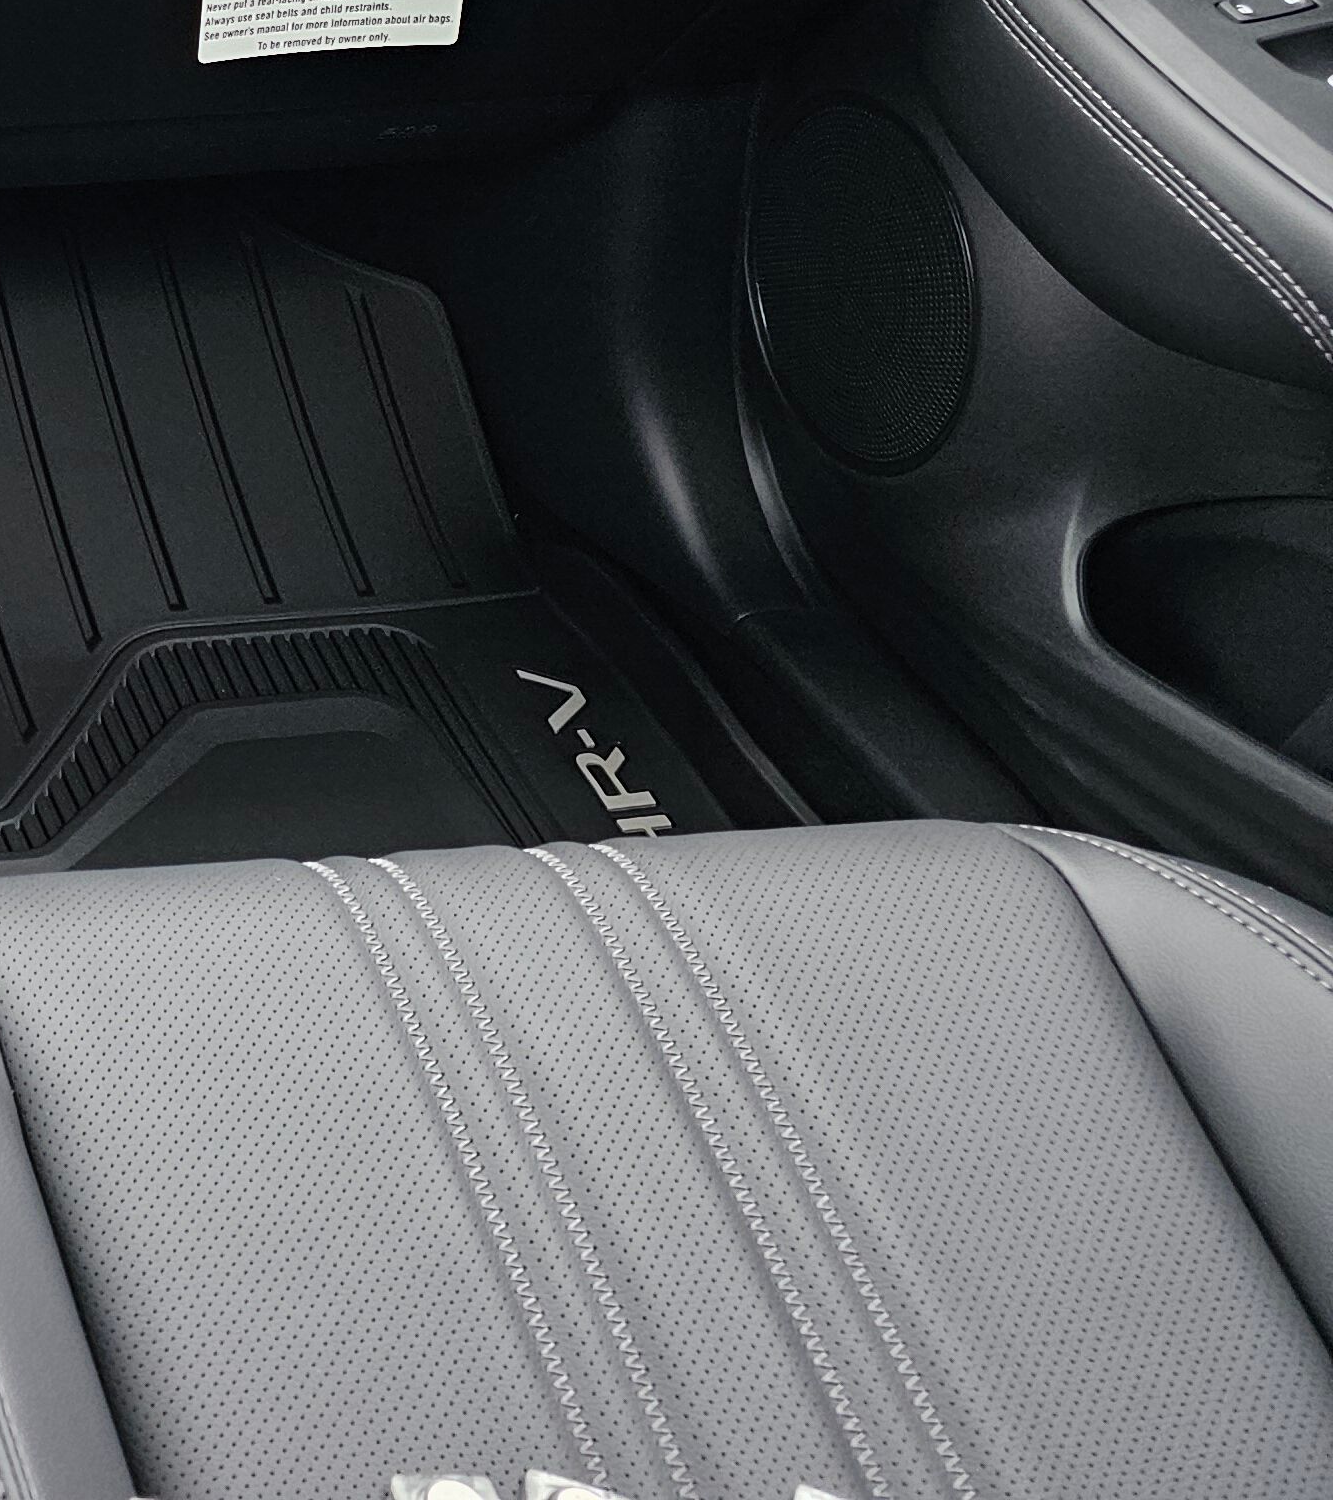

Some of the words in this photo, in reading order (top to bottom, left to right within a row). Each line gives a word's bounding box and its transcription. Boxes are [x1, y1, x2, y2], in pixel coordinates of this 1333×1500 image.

[205, 16, 234, 26] Always
[256, 11, 274, 20] seat
[277, 9, 298, 18] belts
[301, 6, 317, 16] and
[320, 4, 342, 14] child
[345, 3, 392, 12] restraints.
[207, 3, 231, 12] Never
[234, 0, 247, 10] put
[204, 32, 219, 41] See
[223, 27, 254, 38] owner's
[257, 23, 289, 34] manual
[292, 22, 302, 30] for
[306, 21, 328, 29] more
[331, 17, 382, 28] information
[385, 16, 410, 24] about
[413, 15, 426, 23] air
[429, 15, 453, 24] bags.
[258, 41, 267, 50] To
[271, 41, 280, 49] be
[284, 36, 322, 47] removed
[325, 36, 335, 45] by
[339, 34, 366, 43] owner
[369, 33, 390, 42] only.
